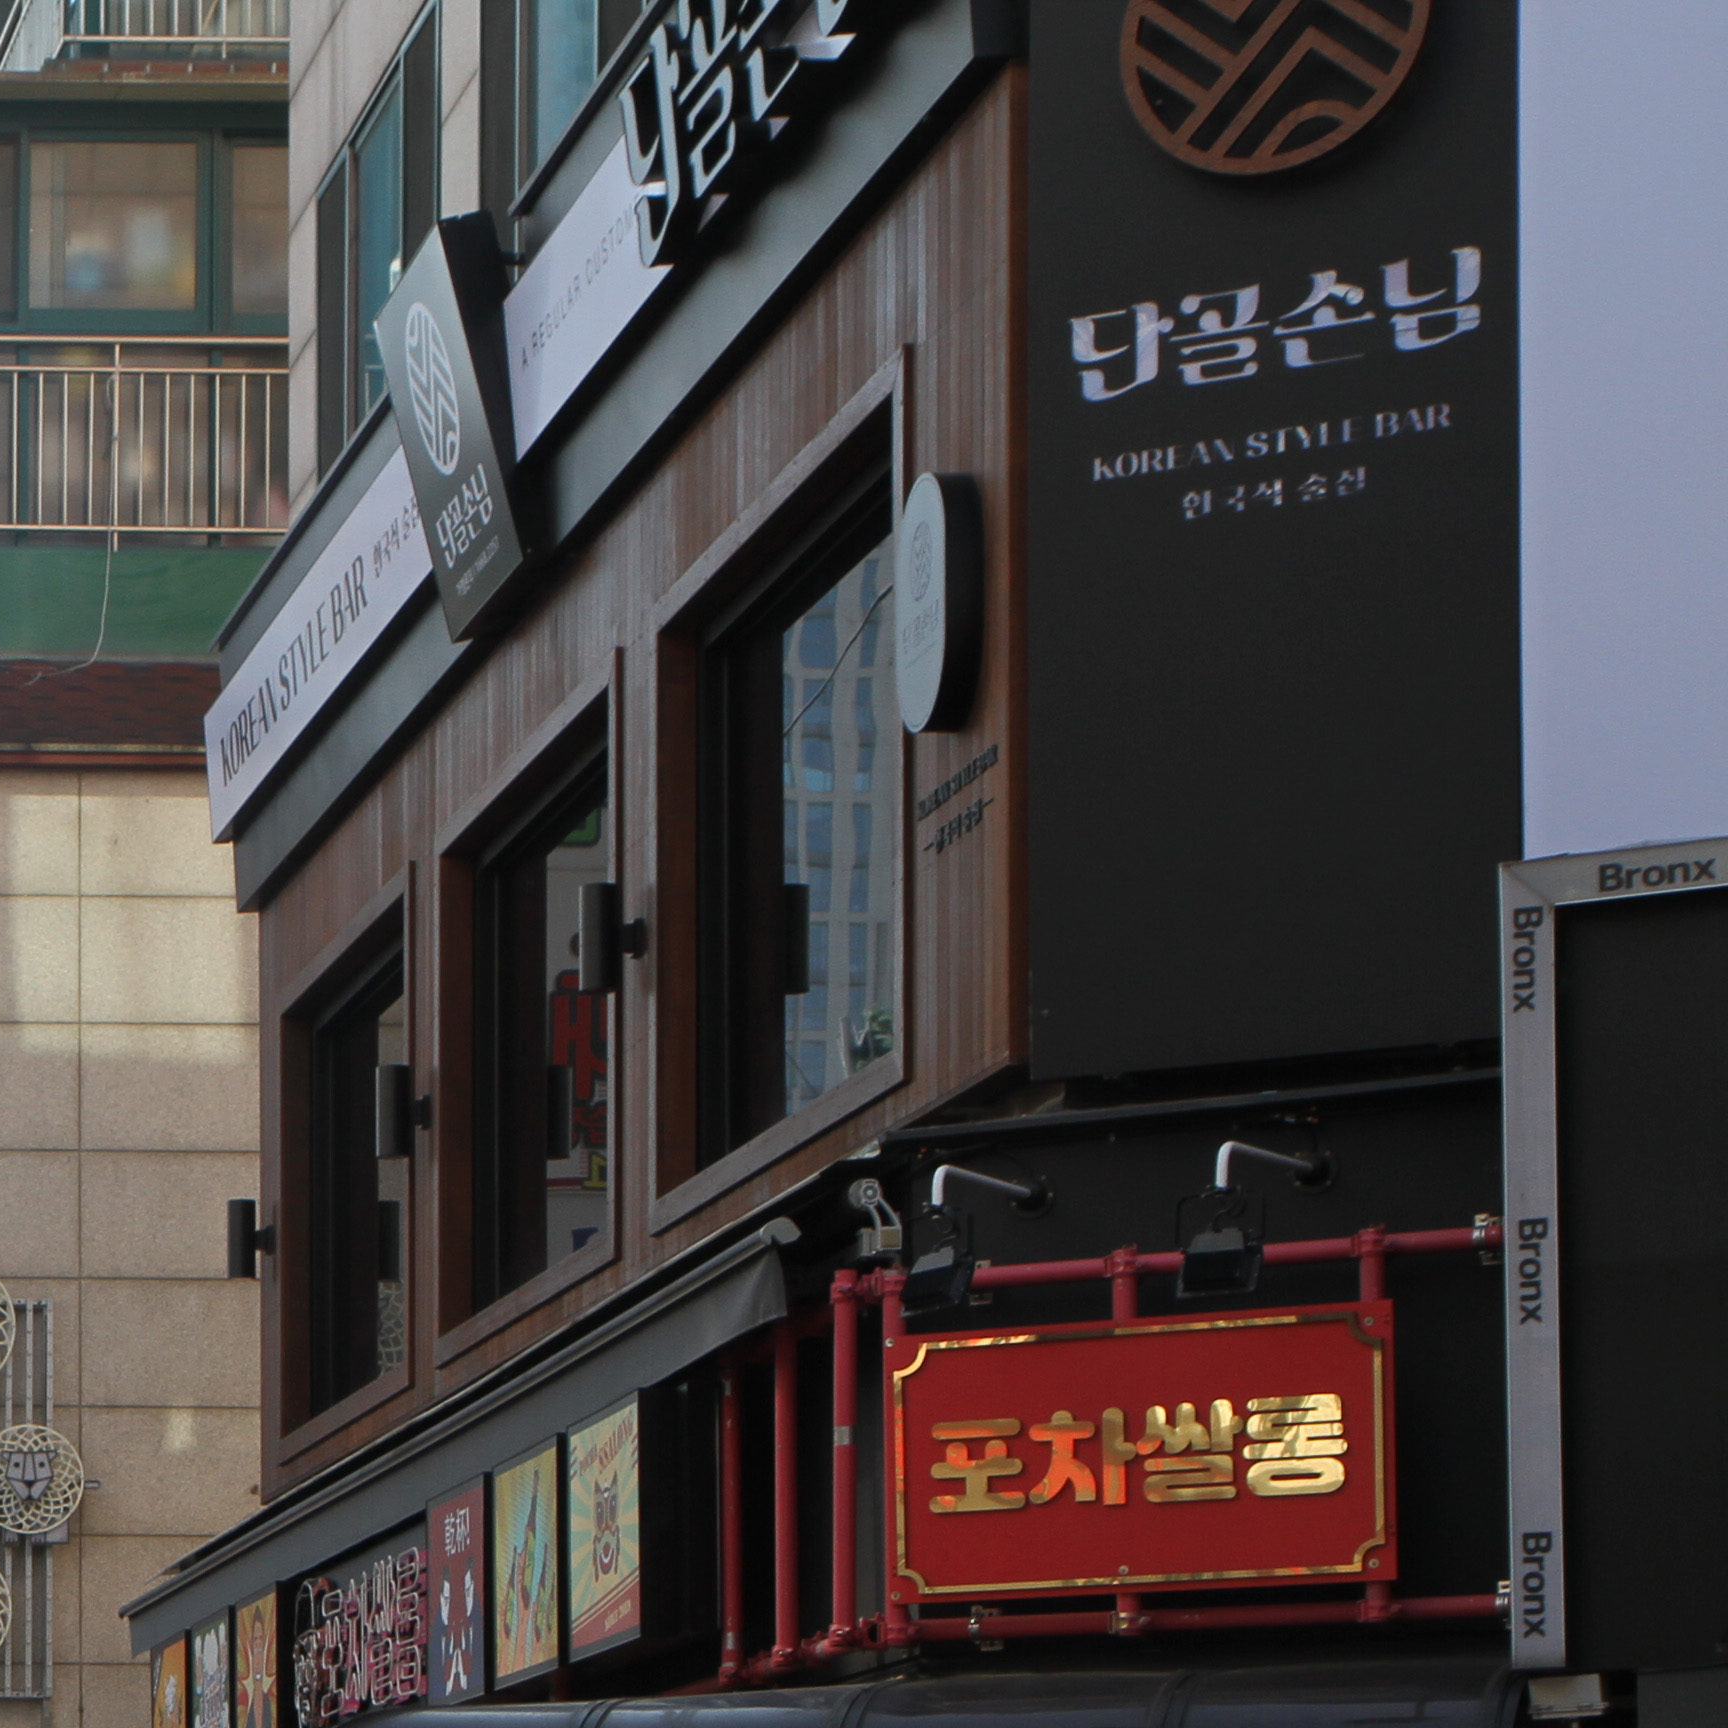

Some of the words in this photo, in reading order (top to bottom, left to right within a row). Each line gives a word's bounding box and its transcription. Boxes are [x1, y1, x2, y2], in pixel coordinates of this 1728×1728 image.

[1069, 246, 1482, 401] 단골손님
[1092, 437, 1235, 482] KOREAN
[1246, 416, 1363, 459] STYLE
[1376, 403, 1451, 438] BAR
[436, 463, 493, 569] 단골손님
[221, 677, 277, 787] KOREAN
[279, 612, 329, 711] STYLE
[330, 554, 368, 657] BAR
[1600, 853, 1716, 892] Bronx
[1516, 1217, 1548, 1326] Bronx
[928, 1393, 1349, 1514] 포차쌀롱
[1522, 1532, 1552, 1640] Bronx
